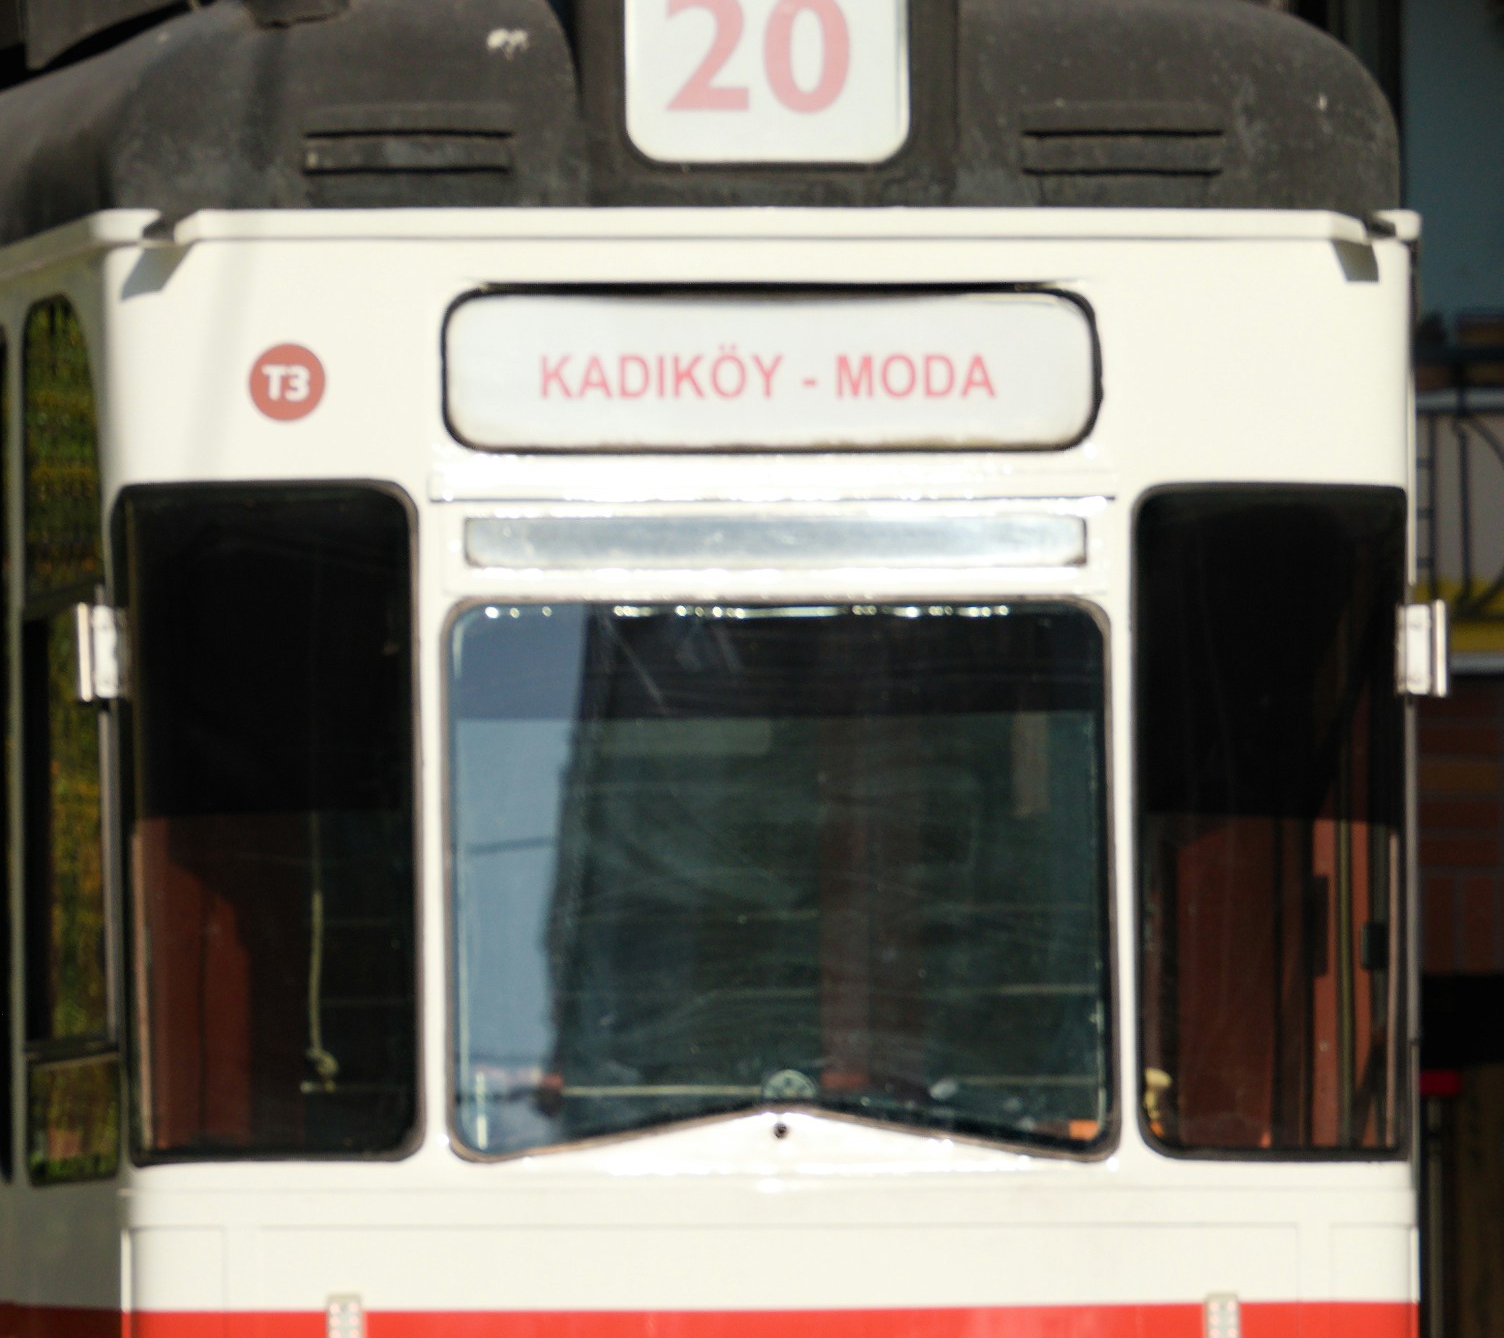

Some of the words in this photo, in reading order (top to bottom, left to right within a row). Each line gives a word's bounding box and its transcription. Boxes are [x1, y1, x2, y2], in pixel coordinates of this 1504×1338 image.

[260, 363, 312, 403] T3
[539, 343, 783, 399] KADIKÖY
[835, 354, 997, 399] MODA
